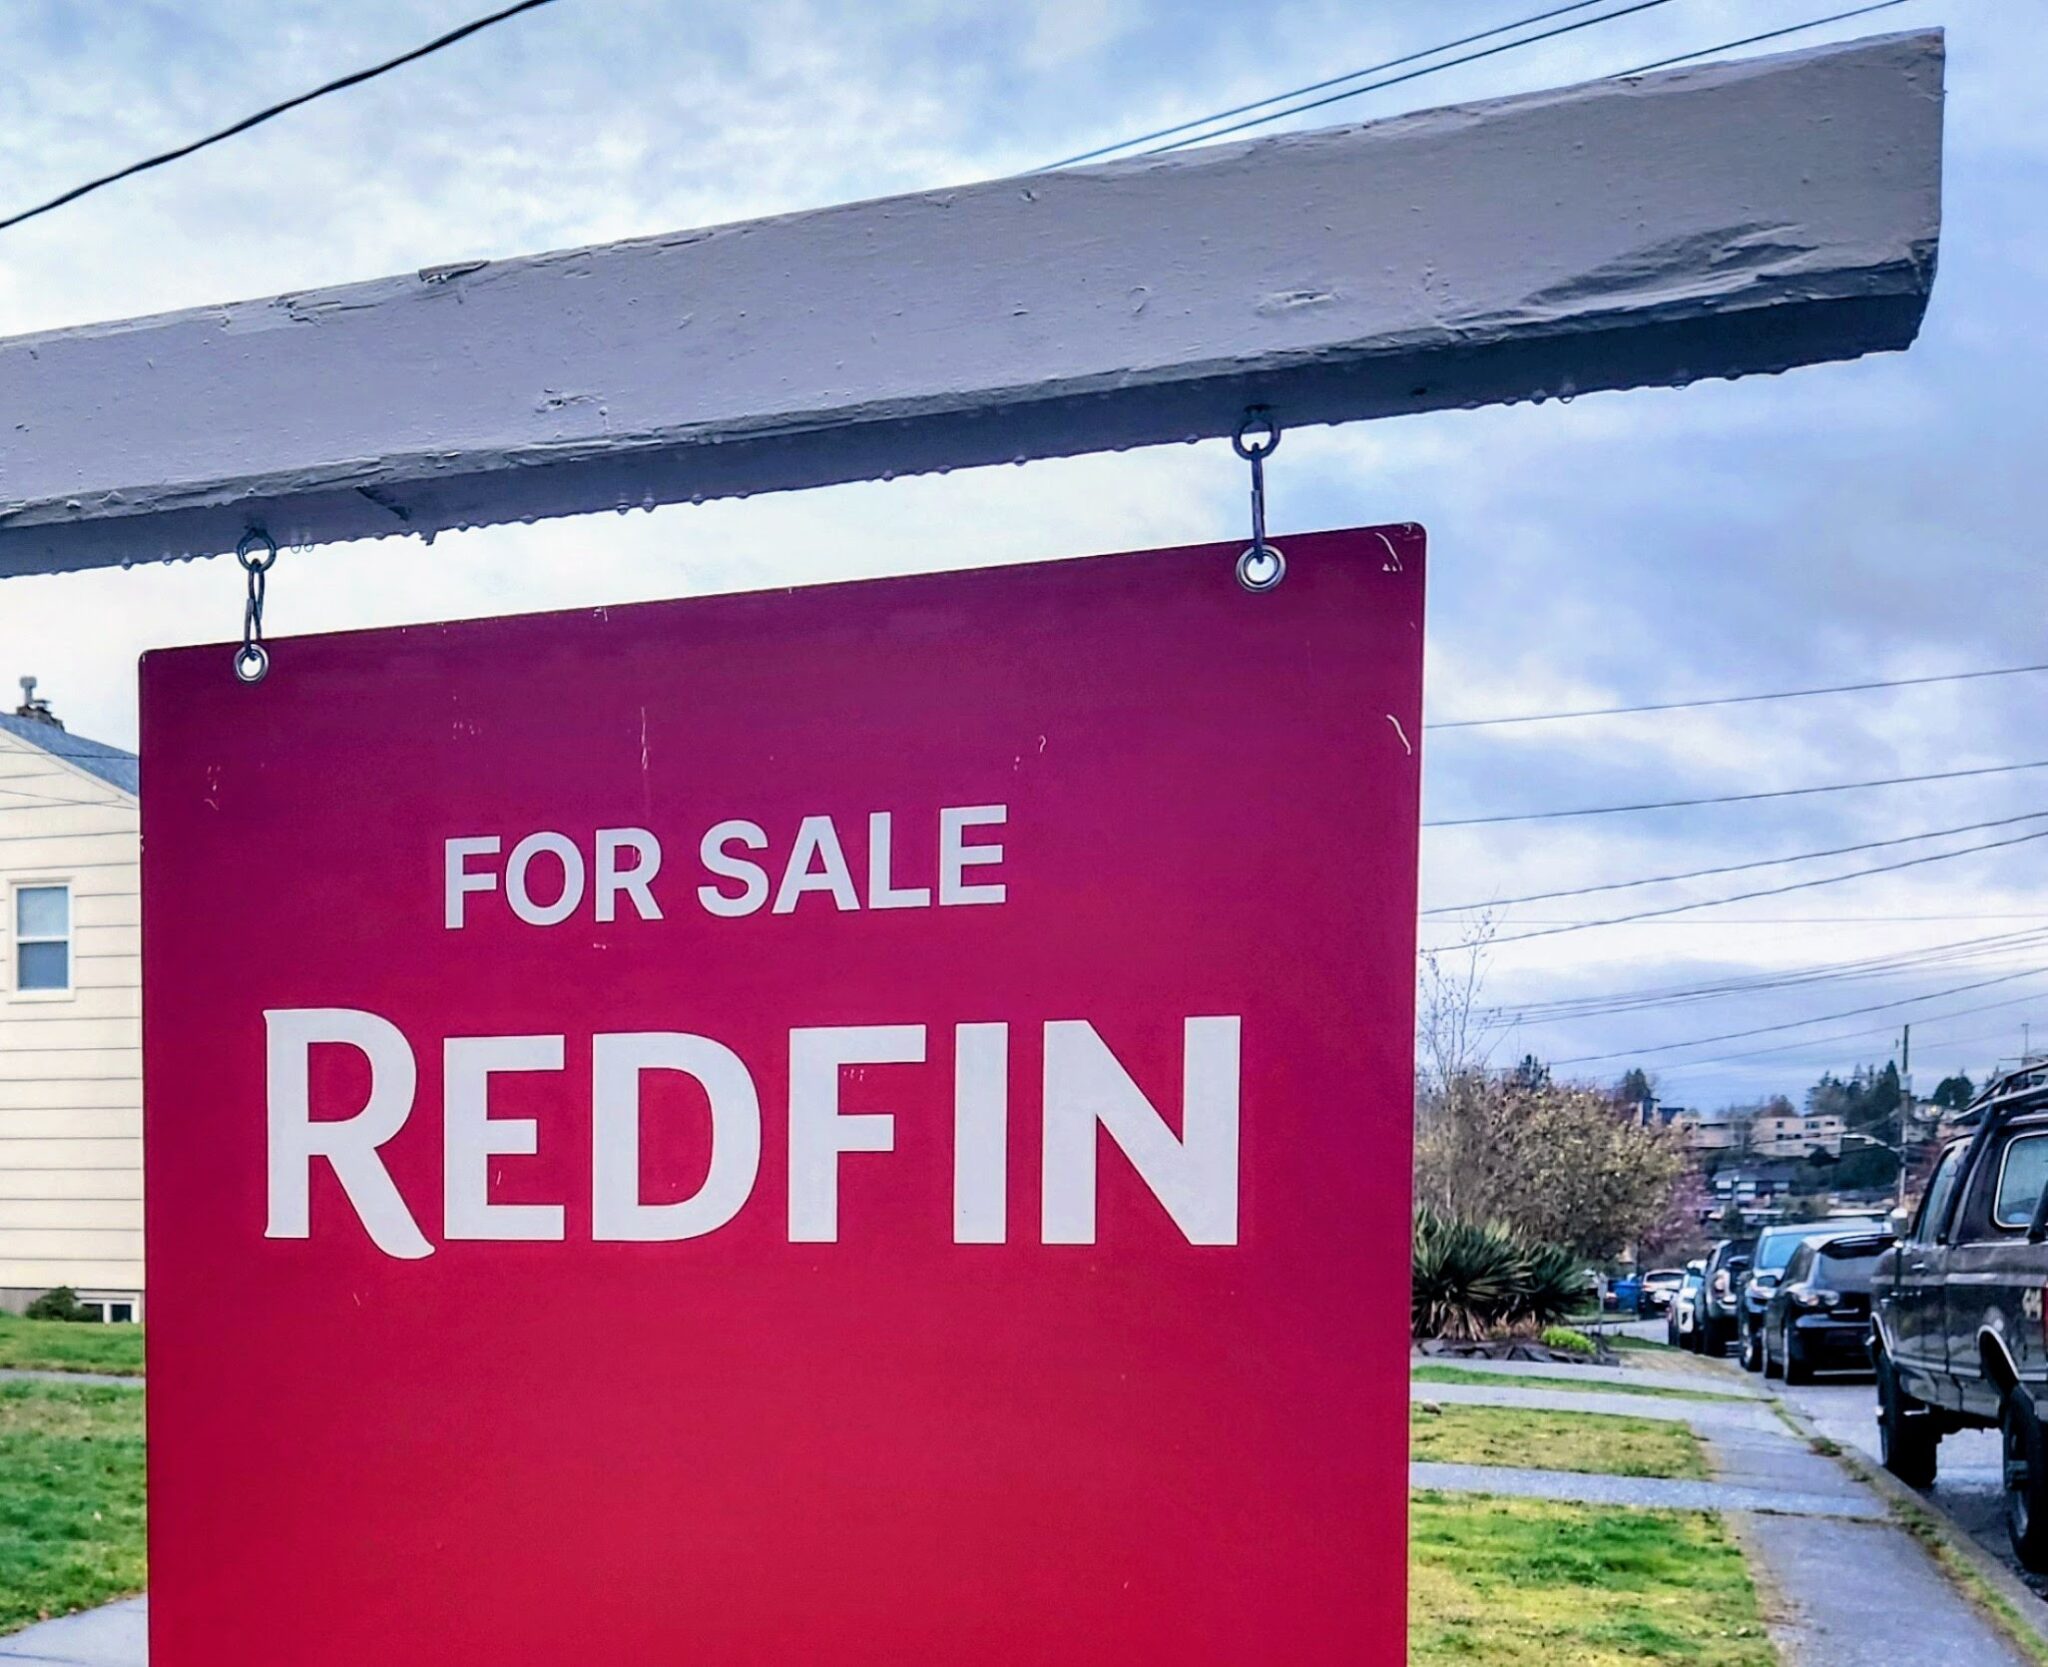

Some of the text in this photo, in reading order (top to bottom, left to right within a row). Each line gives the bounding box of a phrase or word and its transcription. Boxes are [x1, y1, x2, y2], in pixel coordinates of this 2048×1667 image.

[444, 804, 1008, 930] FOR SALE
[262, 1008, 1241, 1259] REDFIN
